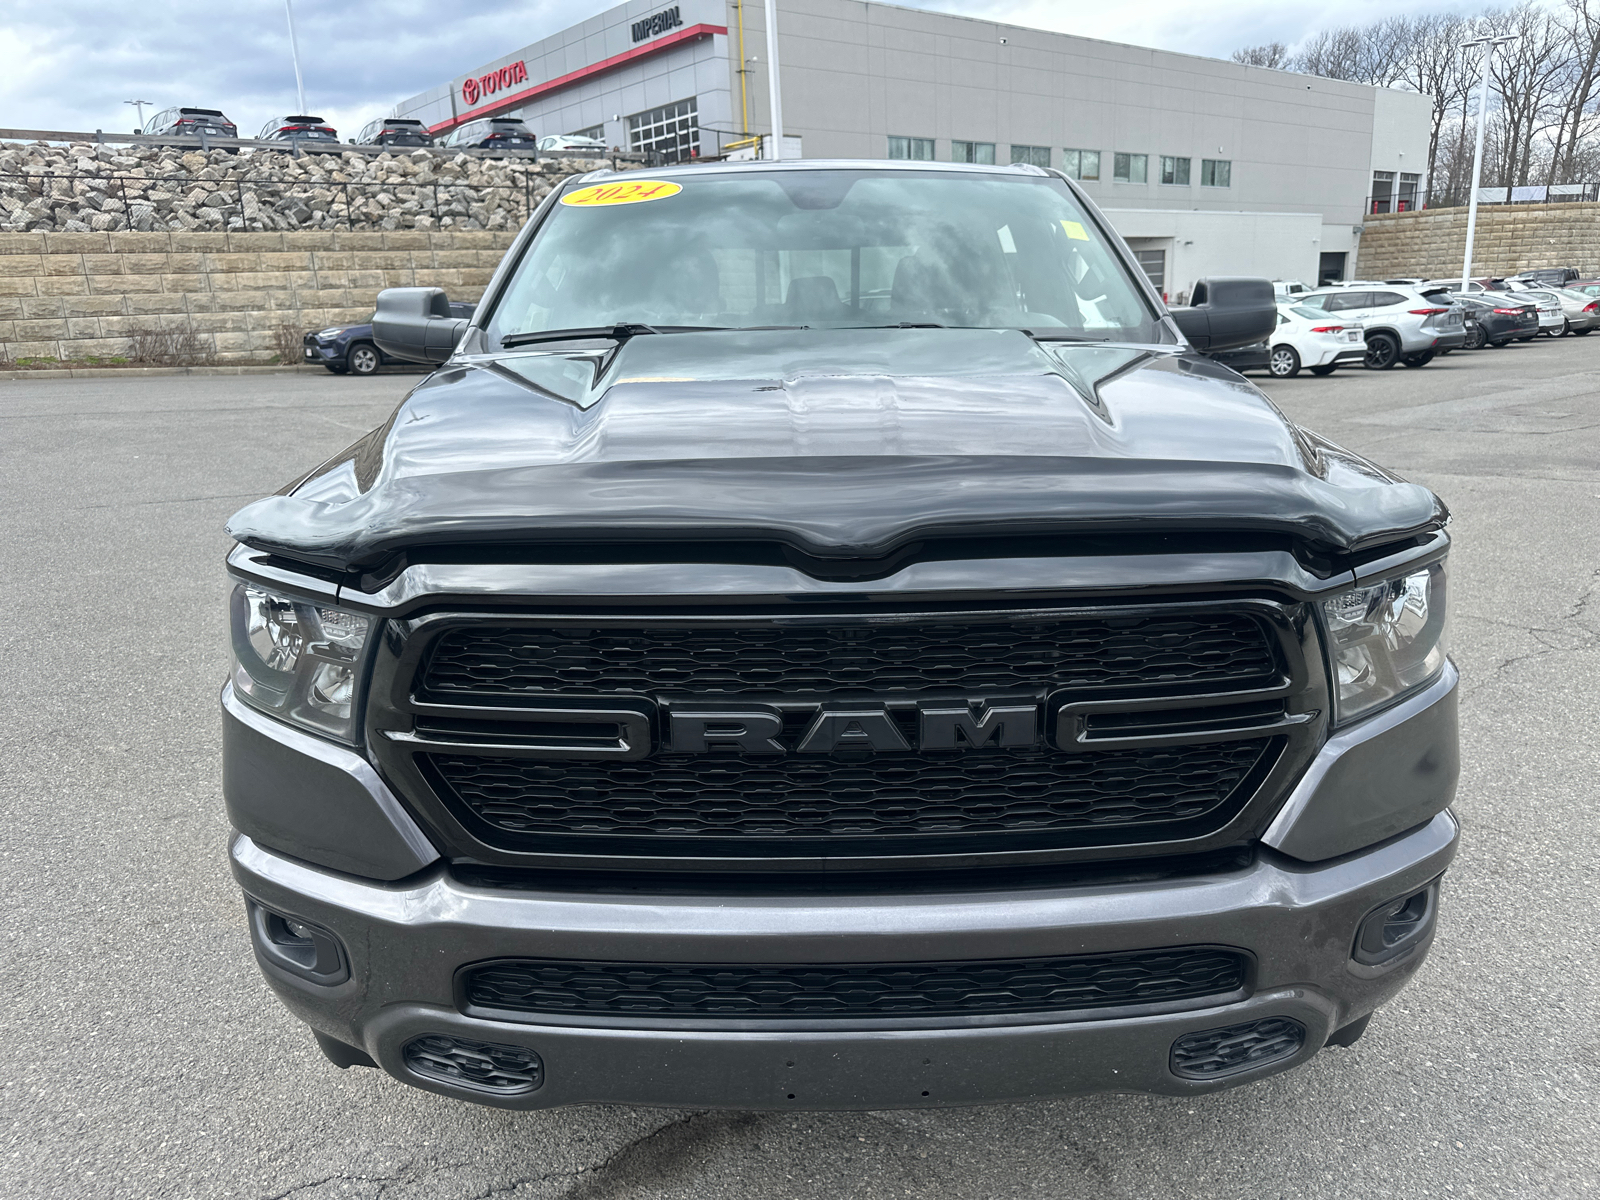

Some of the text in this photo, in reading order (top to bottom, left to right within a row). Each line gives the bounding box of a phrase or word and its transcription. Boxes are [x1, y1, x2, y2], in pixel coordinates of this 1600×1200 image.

[631, 5, 683, 43] IMPERIAL
[478, 60, 529, 97] TOYOTA
[574, 184, 668, 204] 2024
[669, 702, 1038, 753] RAM
